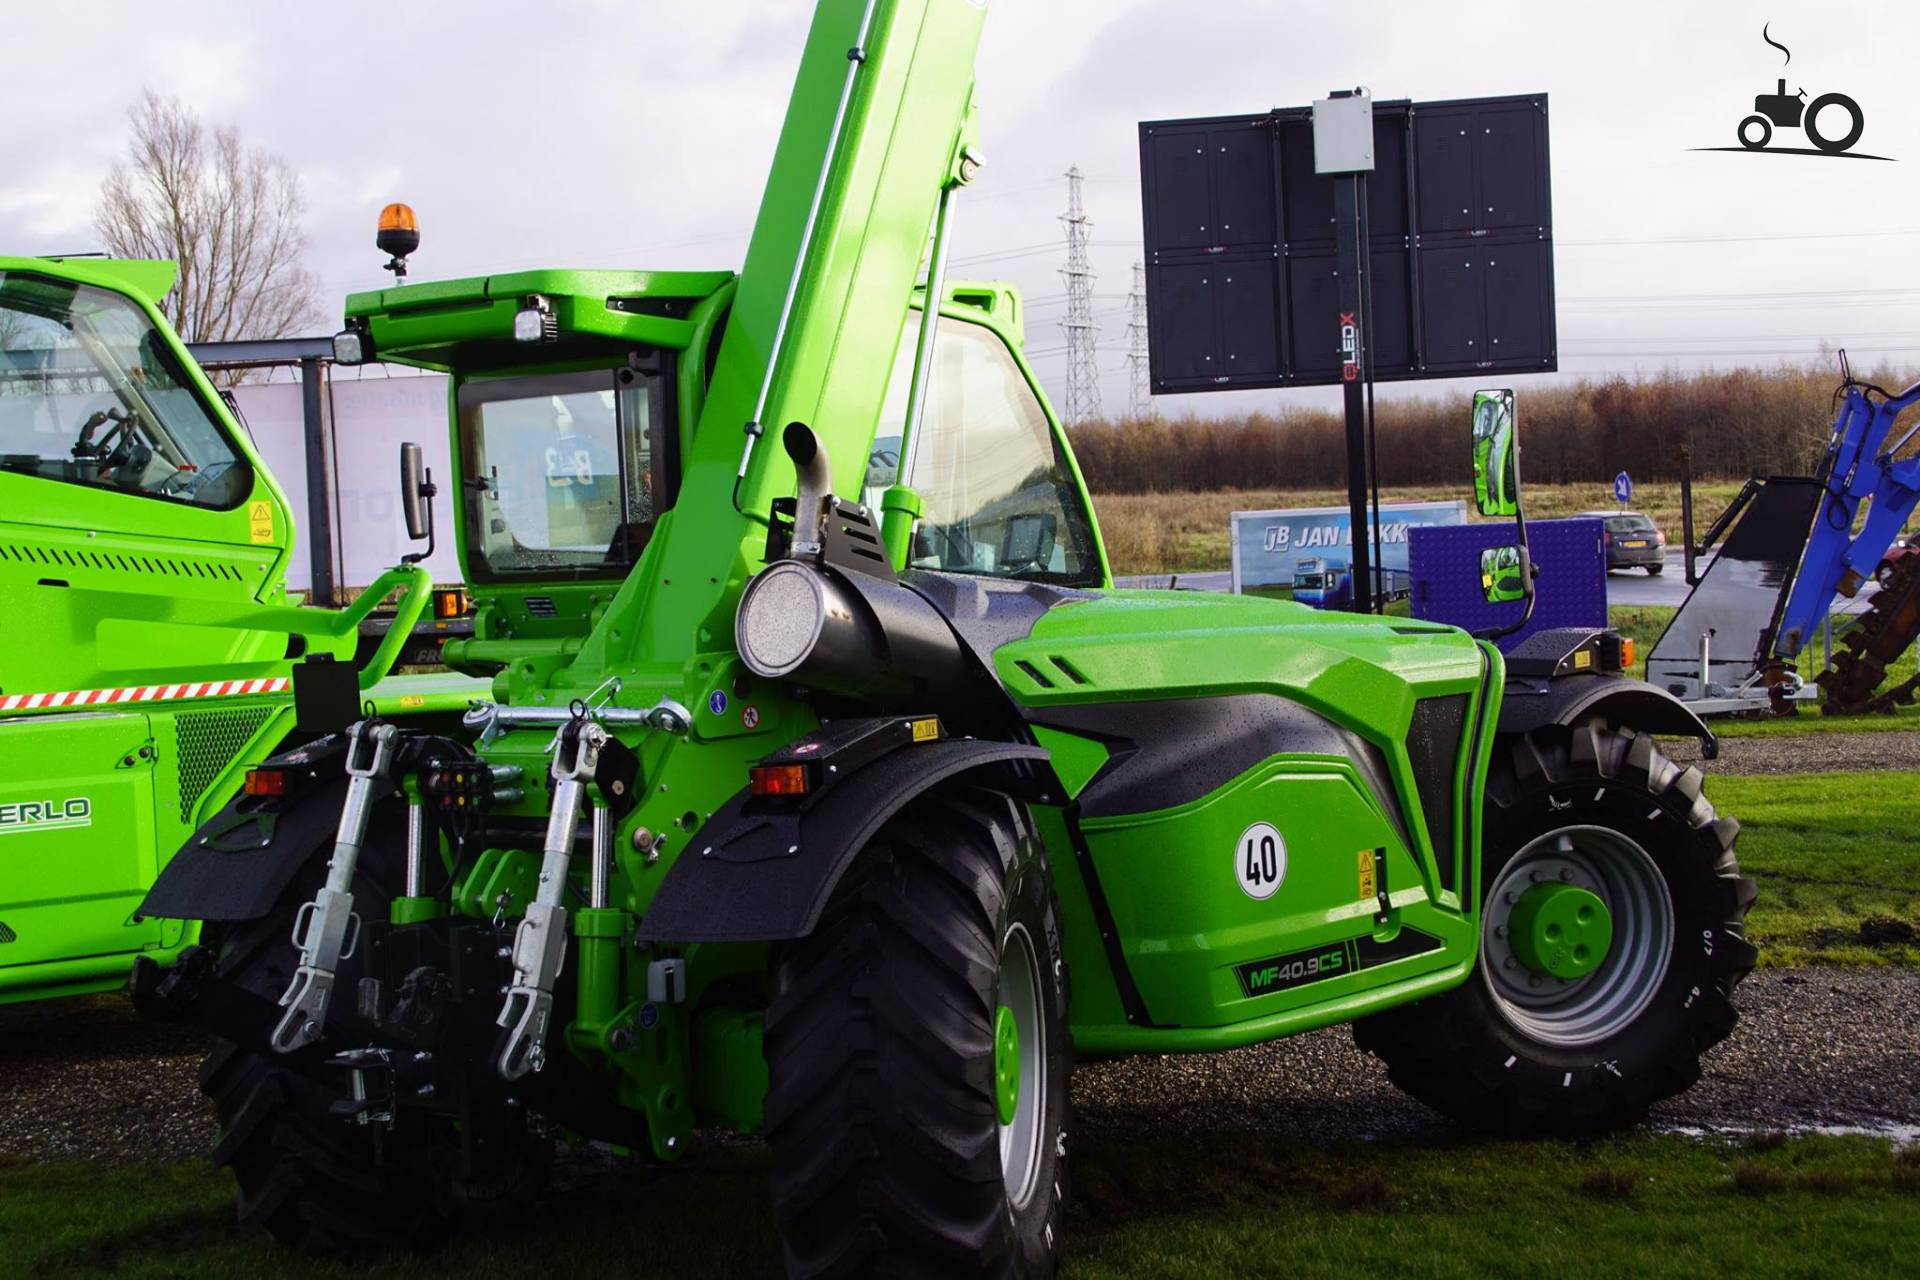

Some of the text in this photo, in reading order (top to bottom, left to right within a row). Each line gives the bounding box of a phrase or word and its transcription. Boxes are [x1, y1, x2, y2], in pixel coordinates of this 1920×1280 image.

[1339, 312, 1359, 381] QLEDX
[1294, 526, 1341, 548] JAN
[1245, 835, 1278, 886] 40
[1250, 950, 1344, 989] MF40.9CS
